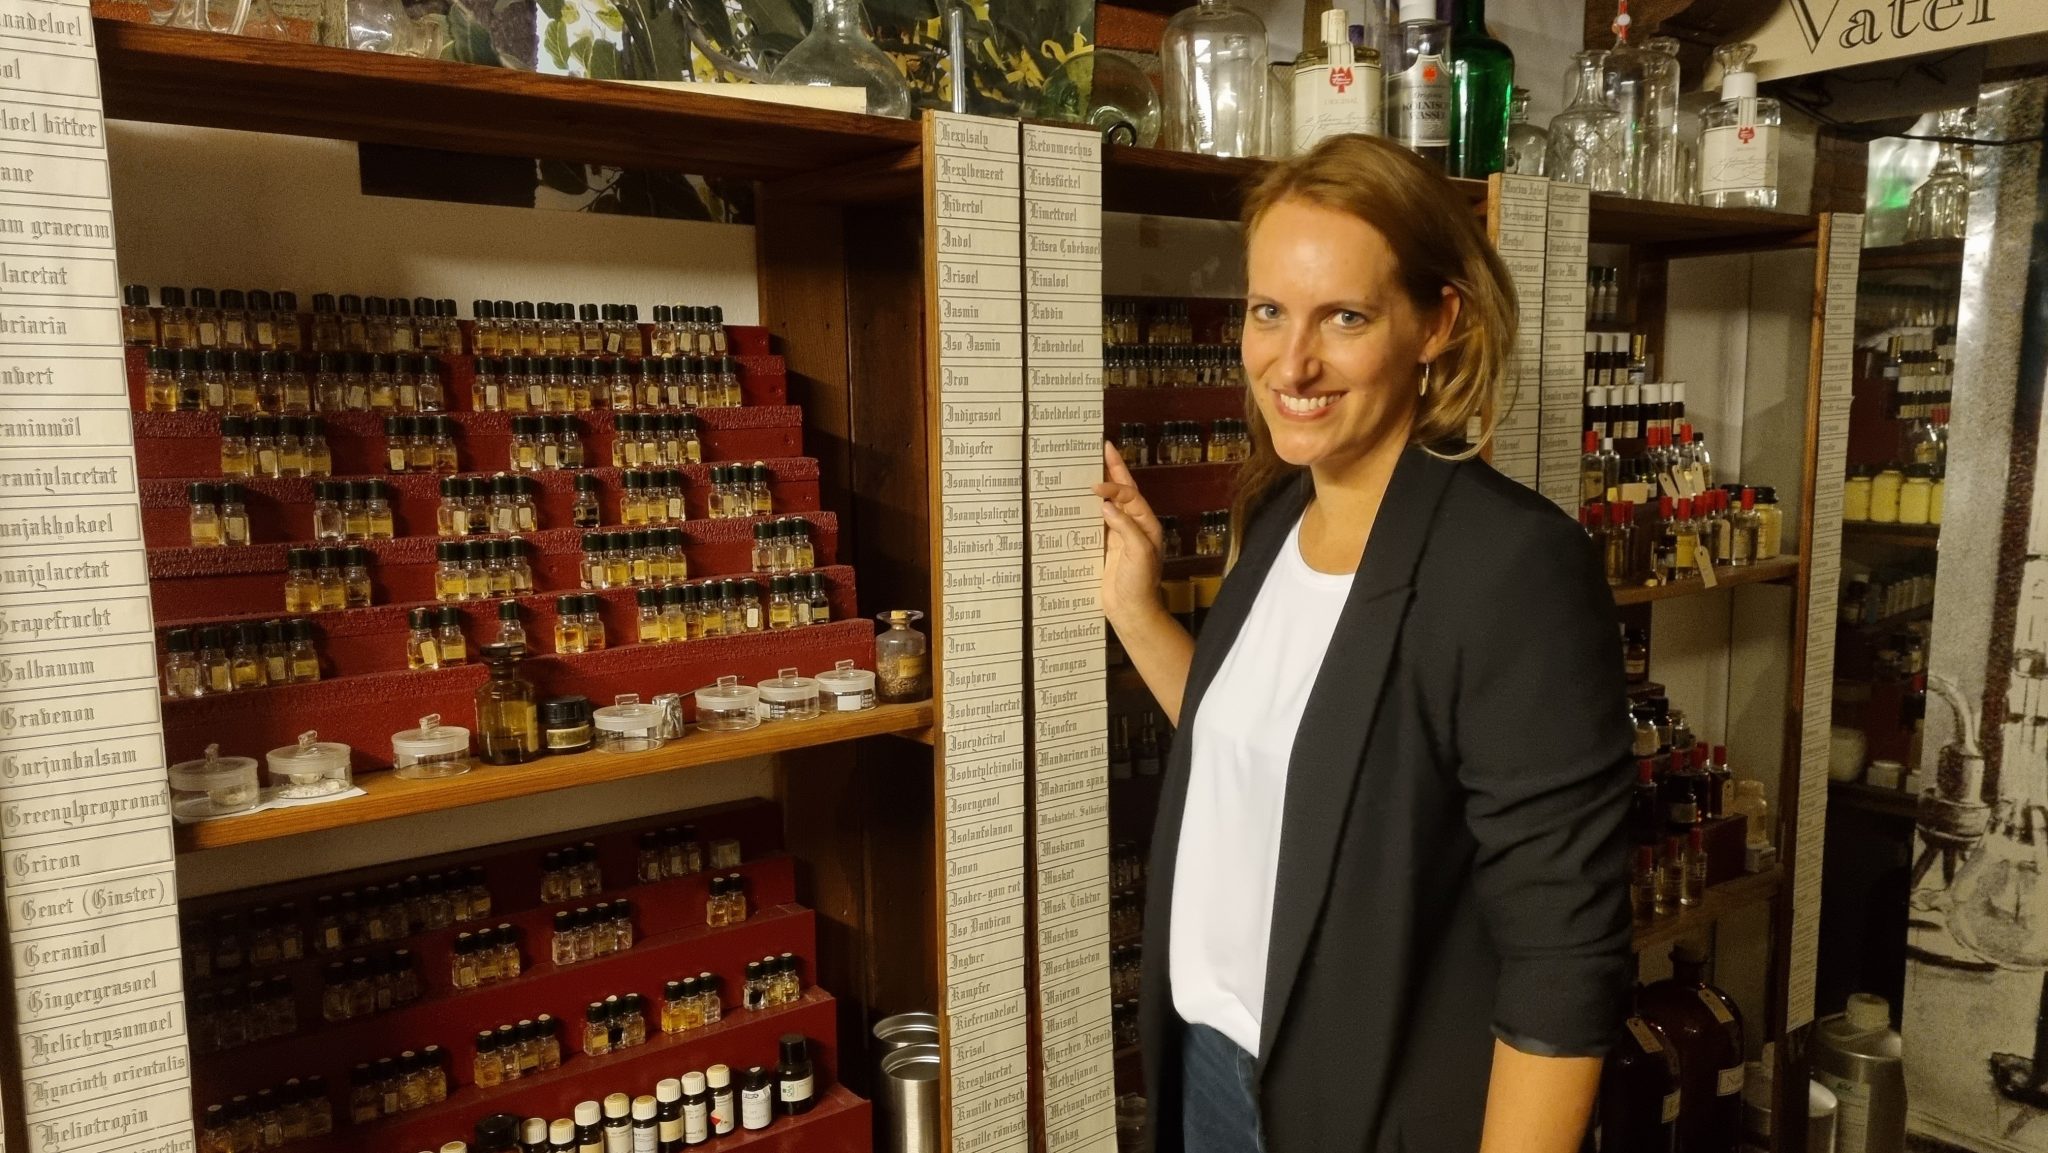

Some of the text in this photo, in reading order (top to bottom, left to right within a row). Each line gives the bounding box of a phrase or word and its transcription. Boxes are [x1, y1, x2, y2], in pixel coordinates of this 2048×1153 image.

[0, 13, 82, 37] nadeloel
[1788, 0, 1996, 54] Vater
[0, 109, 98, 139] loel bitter
[31, 219, 111, 241] graecum
[941, 227, 972, 249] Indol
[1027, 233, 1058, 256] Litsea
[942, 263, 979, 286] Irisoel
[1029, 267, 1069, 290] Linalool
[943, 299, 979, 320] Jasmin
[943, 332, 1001, 352] Iso Jasmin
[943, 367, 970, 387] Iron
[944, 403, 1002, 426] Indigrasoel
[1083, 408, 1101, 423] gras
[944, 437, 994, 459] Indigofer
[1034, 501, 1081, 521] Labdanum
[944, 533, 1023, 557] Isländisch Moos
[1034, 532, 1063, 553] Liliol
[1036, 564, 1095, 584] Linalylacetat
[1036, 622, 1102, 645] Latschenkiefer
[0, 658, 96, 690] Galbanum
[1038, 657, 1087, 676] Lemongras
[946, 668, 997, 689] Isophoron
[946, 697, 1021, 720] Isobornylacetat
[1038, 688, 1078, 707] Liguster
[1, 747, 137, 784] Gurjunbalsam
[1037, 745, 1089, 768] Mandarinen
[1007, 881, 1021, 895] rot
[1040, 867, 1075, 887] Muskat
[20, 877, 166, 927] Genet (Ginster)
[1041, 891, 1101, 916] Musk Tinktur
[948, 920, 968, 939] Iso
[1041, 927, 1079, 946] Moschus
[23, 933, 108, 973] Geraniol
[949, 952, 985, 971] Ingwer
[1042, 951, 1100, 978] Moschusketon
[26, 968, 158, 1018] Gingergrasoel
[949, 981, 991, 1003] Kampfer
[1043, 986, 1080, 1008] Majoran
[954, 999, 1019, 1034] Kiefernadeloel
[955, 1040, 986, 1064] Krisol
[112, 1054, 187, 1086] orientalis
[956, 1086, 1025, 1124] Kamille deutsch
[38, 1108, 150, 1153] Heliotropin
[956, 1116, 1026, 1153] Kamille römisch
